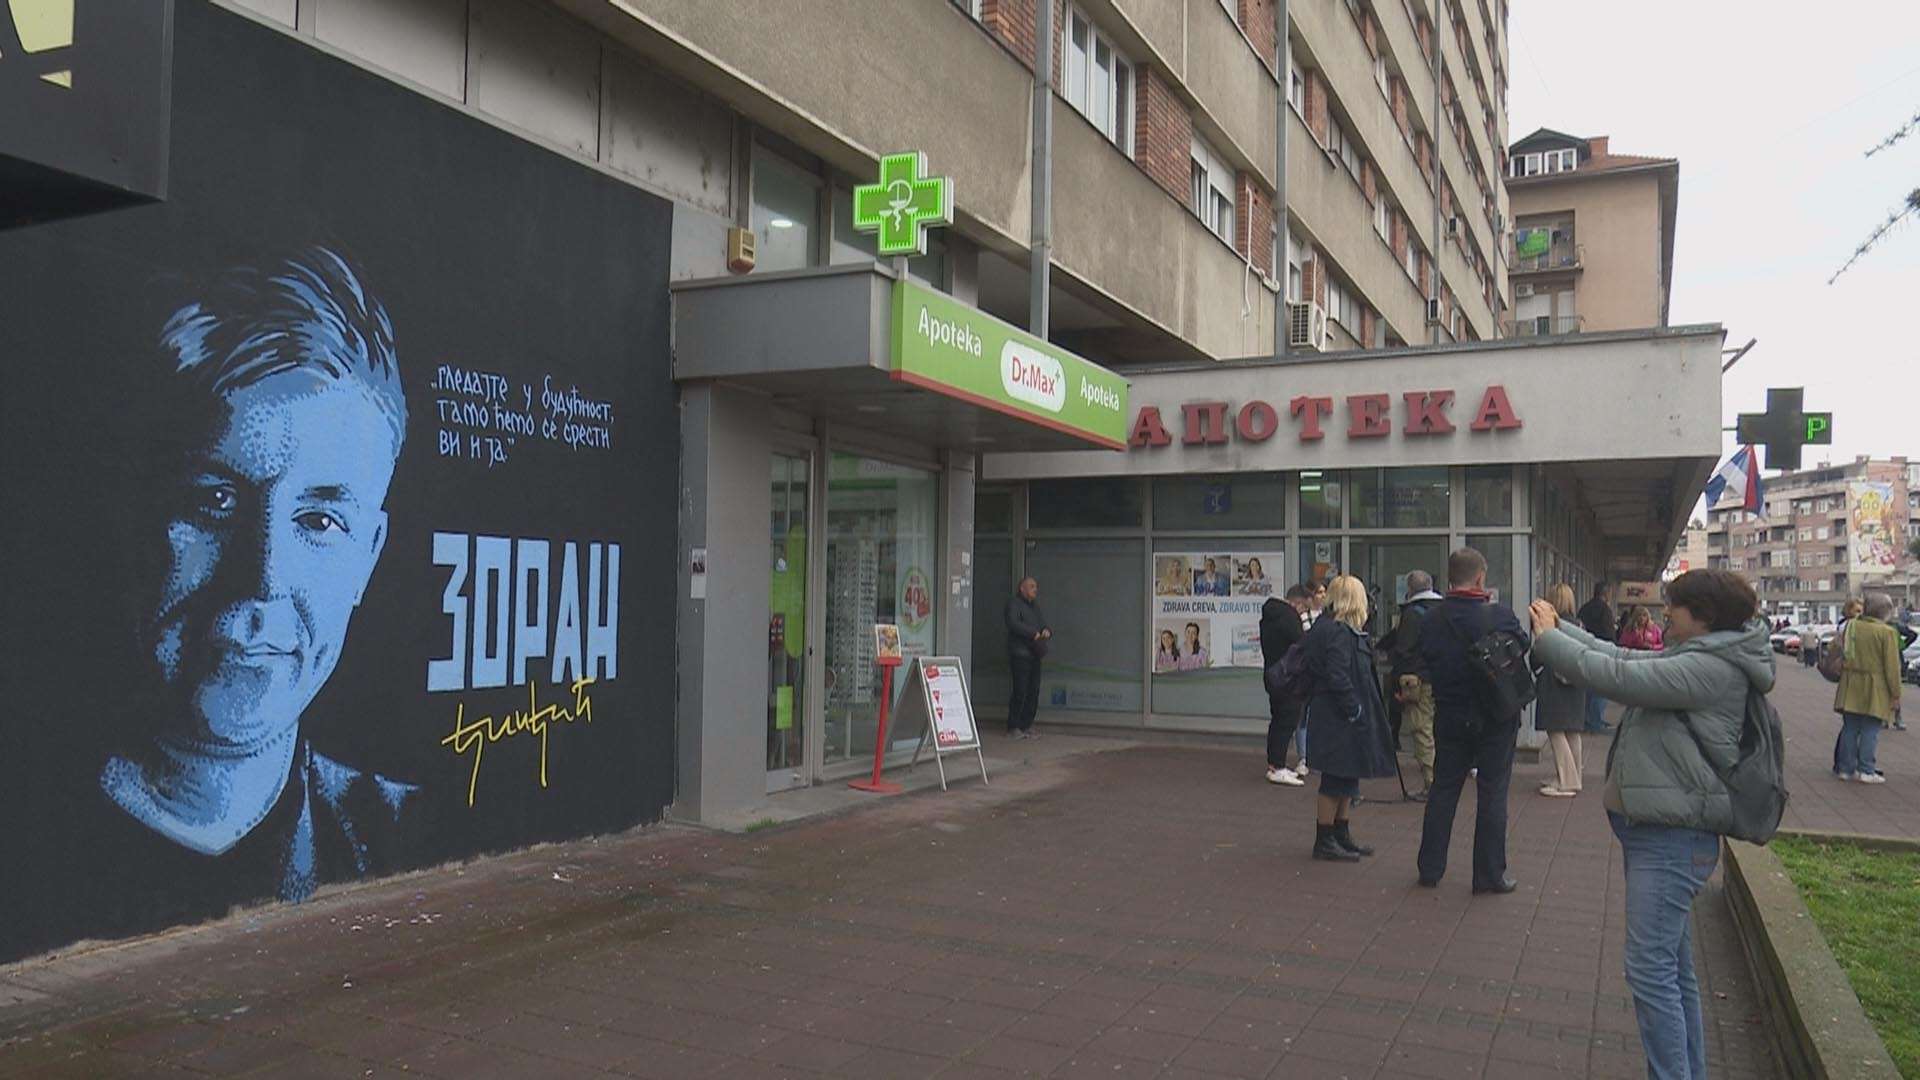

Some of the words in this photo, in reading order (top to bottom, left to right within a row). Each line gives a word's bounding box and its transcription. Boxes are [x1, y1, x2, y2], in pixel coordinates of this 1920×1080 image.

[918, 307, 982, 358] Apoteka
[1080, 375, 1120, 411] Apoteka
[541, 417, 558, 440] се
[563, 422, 610, 451] срести
[1128, 385, 1523, 447] АПОТЕКА
[1807, 417, 1826, 440] P
[427, 531, 620, 691] ЗОРАН
[1163, 602, 1191, 613] ZDRAVA
[1219, 602, 1250, 613] ZDRAVO
[1252, 602, 1263, 613] TE
